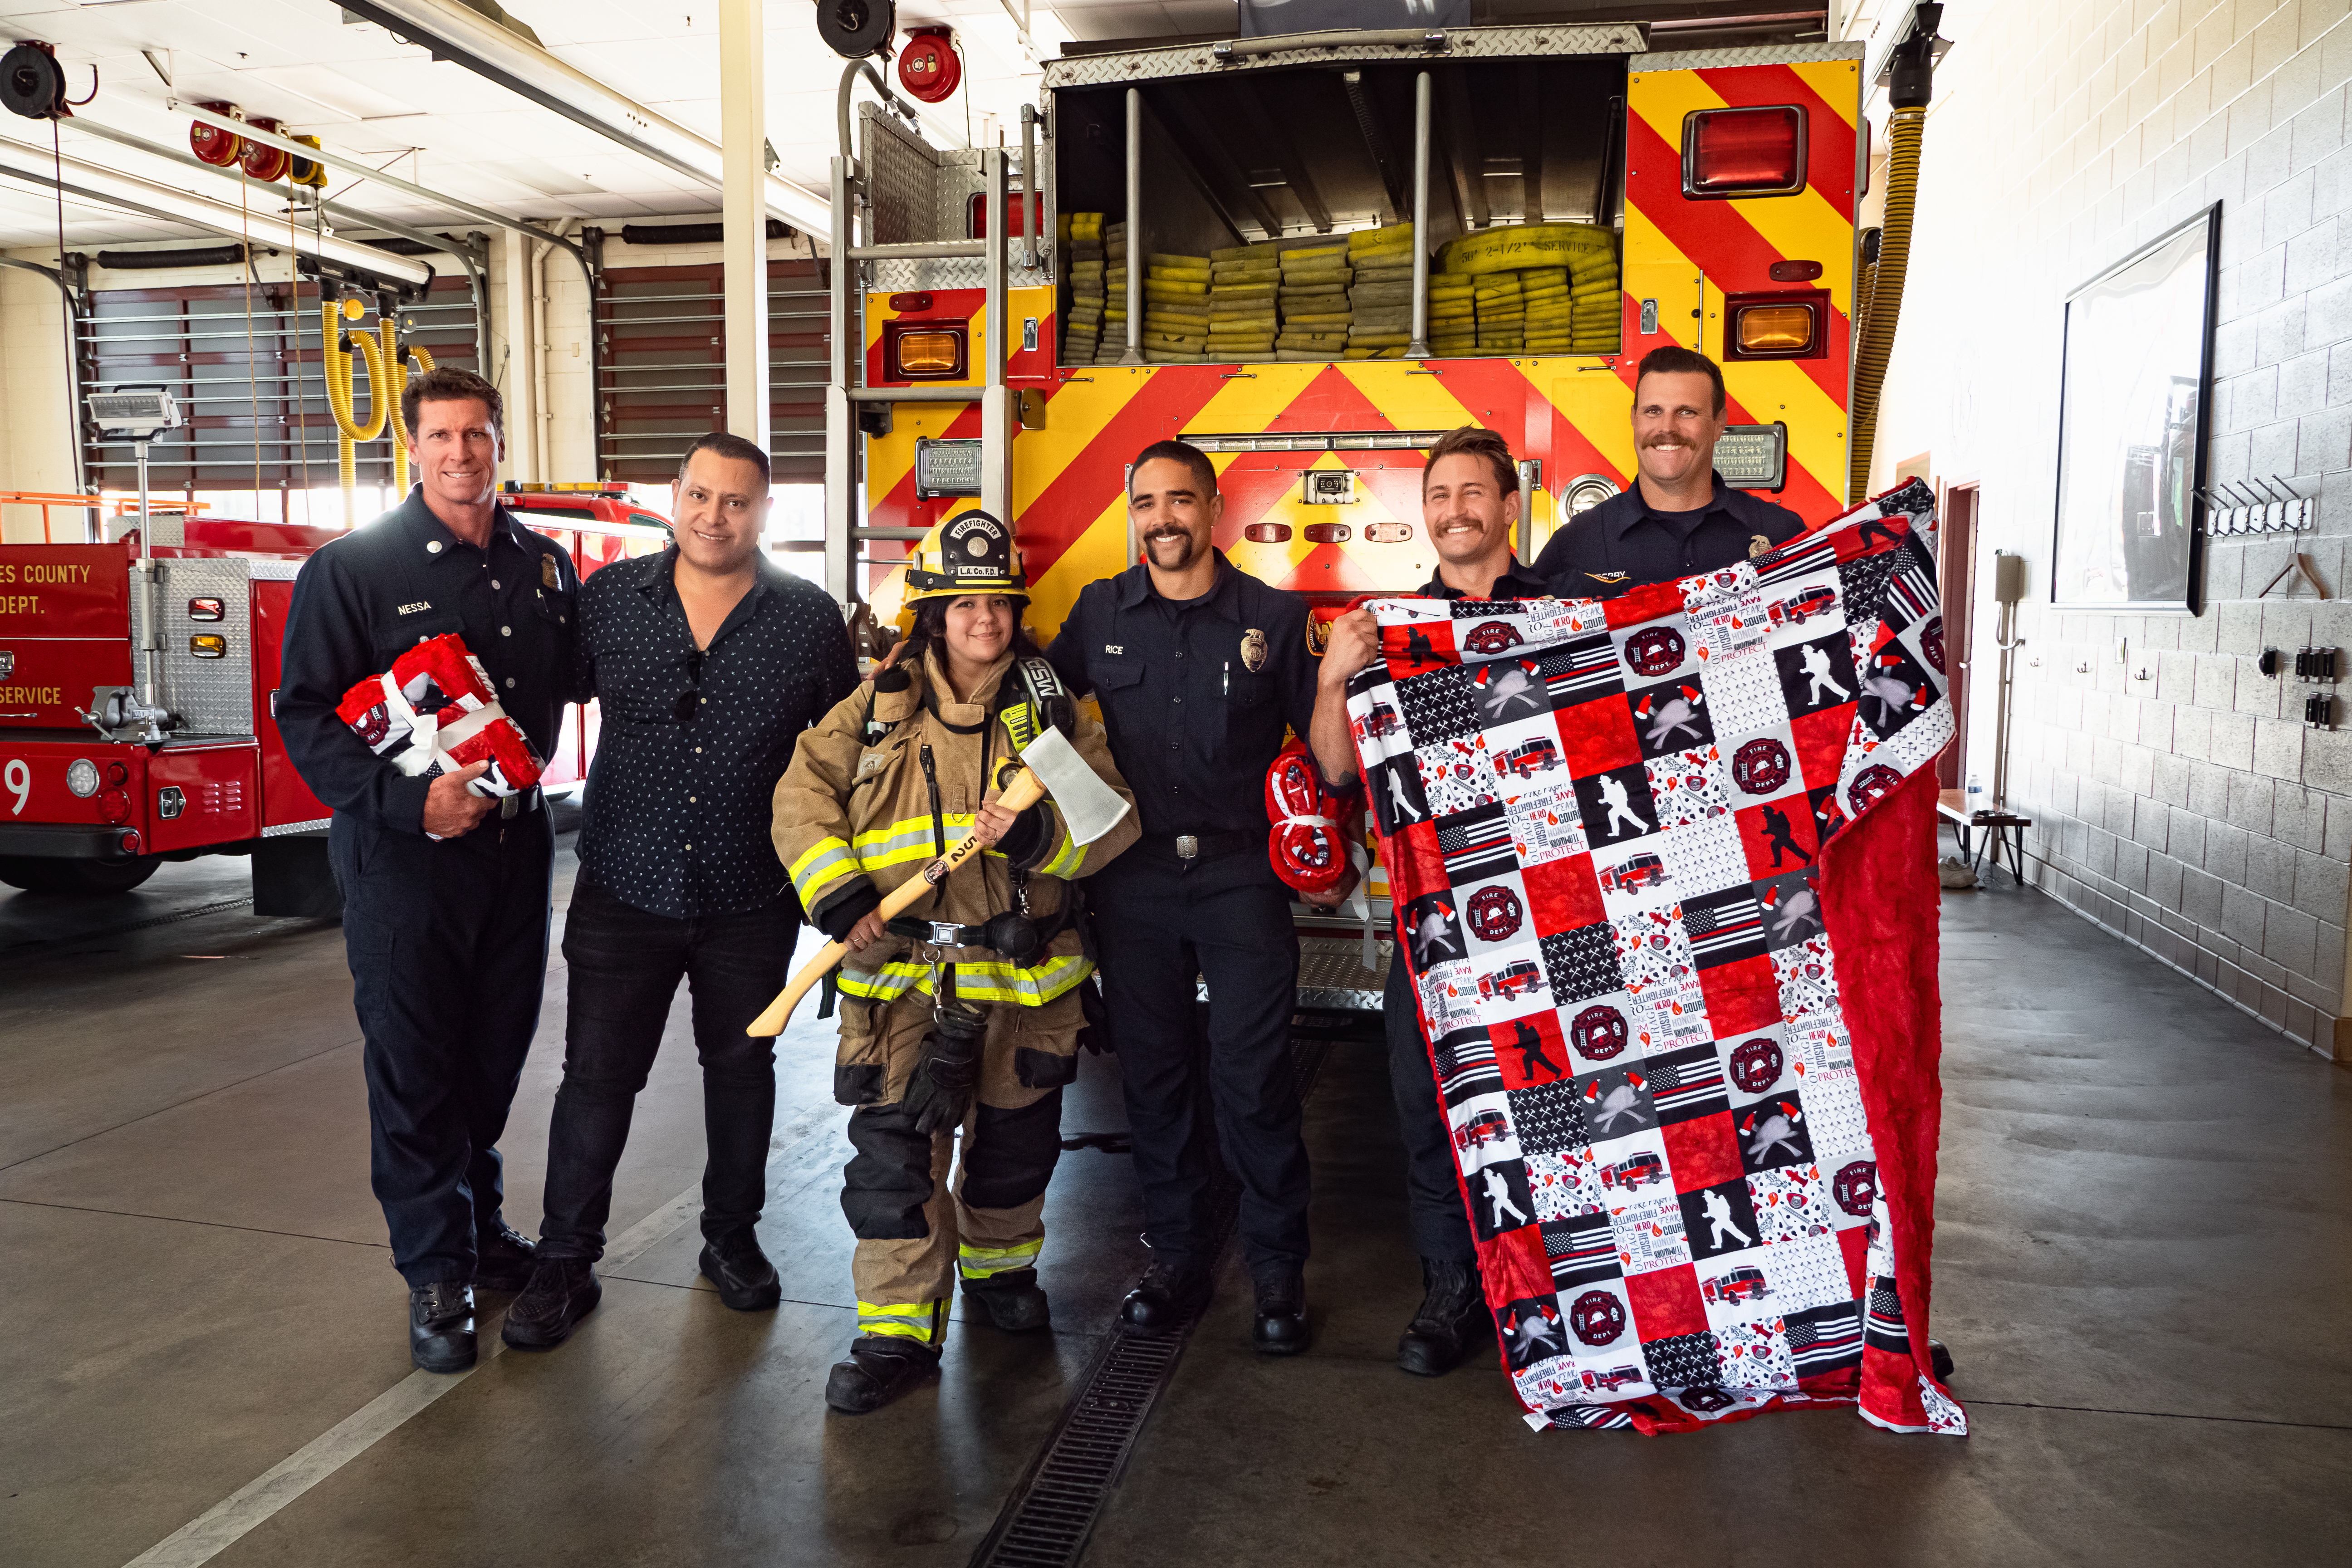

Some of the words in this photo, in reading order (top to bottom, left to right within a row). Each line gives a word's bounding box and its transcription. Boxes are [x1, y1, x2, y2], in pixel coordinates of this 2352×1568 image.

[1544, 241, 1590, 254] SERVICE
[955, 520, 998, 537] FIREFIGHTER
[24, 565, 91, 583] COUNTY
[0, 596, 45, 614] DEPT.
[398, 601, 431, 616] NESSA
[1689, 603, 1738, 623] FIREFIGHTER
[1553, 616, 1570, 628] HERO
[1712, 614, 1731, 627] HERO
[1482, 628, 1500, 636] FIRE
[1641, 632, 1659, 640] FIRE
[1731, 627, 1758, 642] HONOR
[1716, 627, 1733, 652] RESCUE
[1105, 645, 1123, 655] RICE
[1721, 642, 1767, 662] PROTECT
[1649, 661, 1671, 671] DEPT.
[1025, 659, 1058, 697] MSA
[0, 687, 62, 705] SERVICE
[367, 730, 380, 740] FIRE
[1749, 745, 1767, 755] FIRE
[5, 759, 30, 815] 9
[1755, 779, 1776, 789] DEPT.
[1508, 796, 1553, 815] FIREFIGHTER
[1529, 809, 1546, 821] HERO
[1533, 821, 1549, 848] RESCUE
[1547, 824, 1573, 838] HONOR
[1520, 814, 1540, 863] OURAGE
[1549, 833, 1579, 848] TEAMWORK
[1539, 841, 1584, 860] PROTECT
[1481, 892, 1498, 901] FIRE
[1490, 926, 1509, 935] DEPT.
[1633, 986, 1678, 1005] FIREFIGHTER
[1447, 998, 1471, 1009] HONOR
[1654, 999, 1671, 1010] HERO
[1588, 1012, 1604, 1020] FIRE
[1671, 1014, 1697, 1028] HONOR
[1442, 1015, 1481, 1033] PROTECT
[1645, 1004, 1663, 1052] OURAGE
[1657, 1011, 1673, 1037] RESCUE
[1674, 1024, 1704, 1038] TEAMWORK
[1788, 1017, 1833, 1034] FIREFIGHTER
[1664, 1031, 1709, 1050] PROTECT
[1809, 1029, 1826, 1040] HERO
[1594, 1045, 1614, 1054] DEPT.
[1746, 1045, 1762, 1053] FIRE
[1812, 1042, 1828, 1069] RESCUE
[1826, 1047, 1852, 1059] HONOR
[1799, 1034, 1818, 1083] OURAGE
[1850, 1167, 1867, 1176] FIRE
[1612, 1209, 1657, 1226] FIREFIGHTER
[1634, 1220, 1651, 1232] HERO
[1625, 1225, 1644, 1272] OURAGE
[1637, 1232, 1653, 1258] RESCUE
[1651, 1236, 1676, 1249] HONOR
[1653, 1245, 1683, 1258] TEAMWORK
[1643, 1252, 1687, 1269] PROTECT
[1585, 1296, 1602, 1305] FIRE
[1592, 1330, 1612, 1339] DEPT.
[1516, 1365, 1556, 1387] FIREFIGHTER
